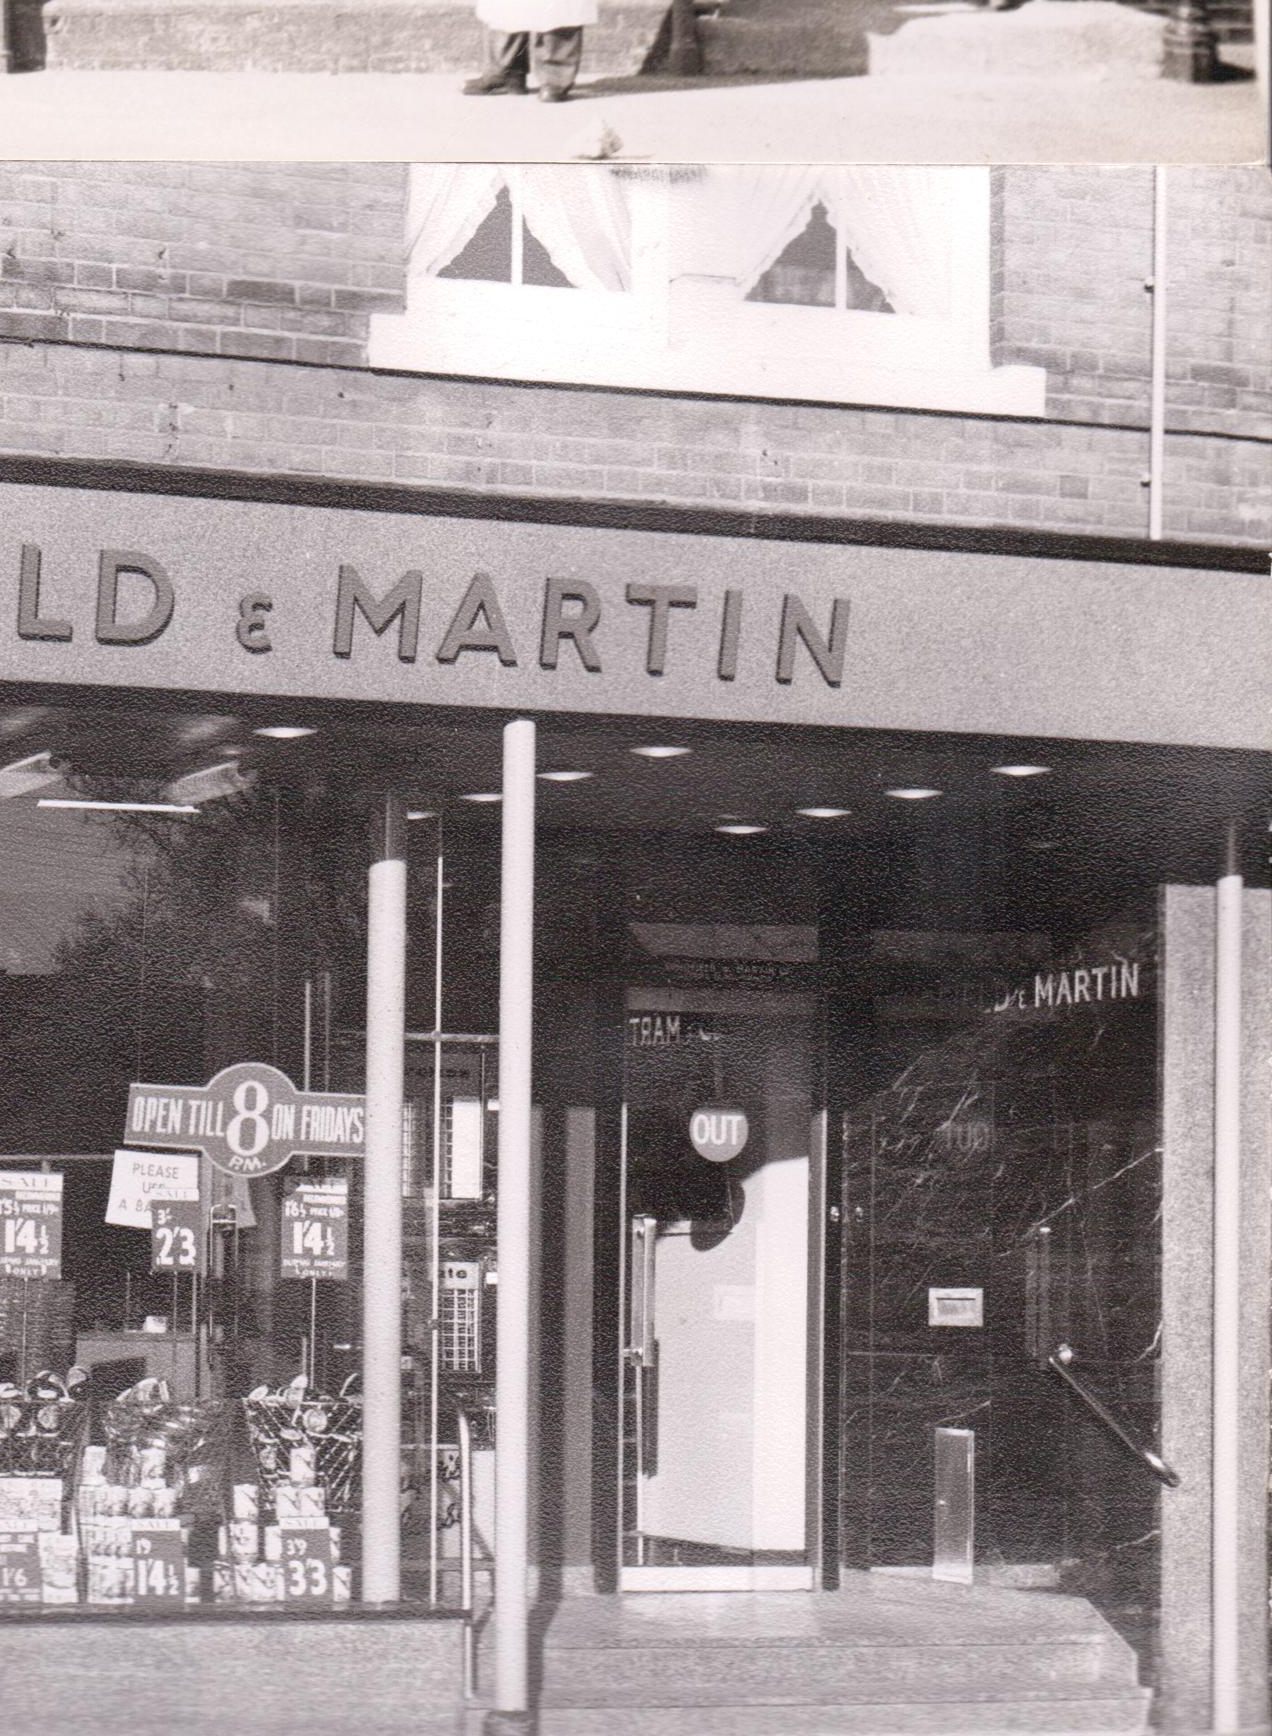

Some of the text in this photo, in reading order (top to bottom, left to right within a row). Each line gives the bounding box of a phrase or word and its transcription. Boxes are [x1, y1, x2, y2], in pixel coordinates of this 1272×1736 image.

[233, 589, 275, 655] &
[330, 563, 853, 690] MARTIN
[1033, 962, 1140, 1008] MARTIN
[131, 1079, 365, 1156] OPEN TILL 8 ON FRIDAYS
[692, 1113, 744, 1146] OUT
[132, 1162, 179, 1181] PLEASE
